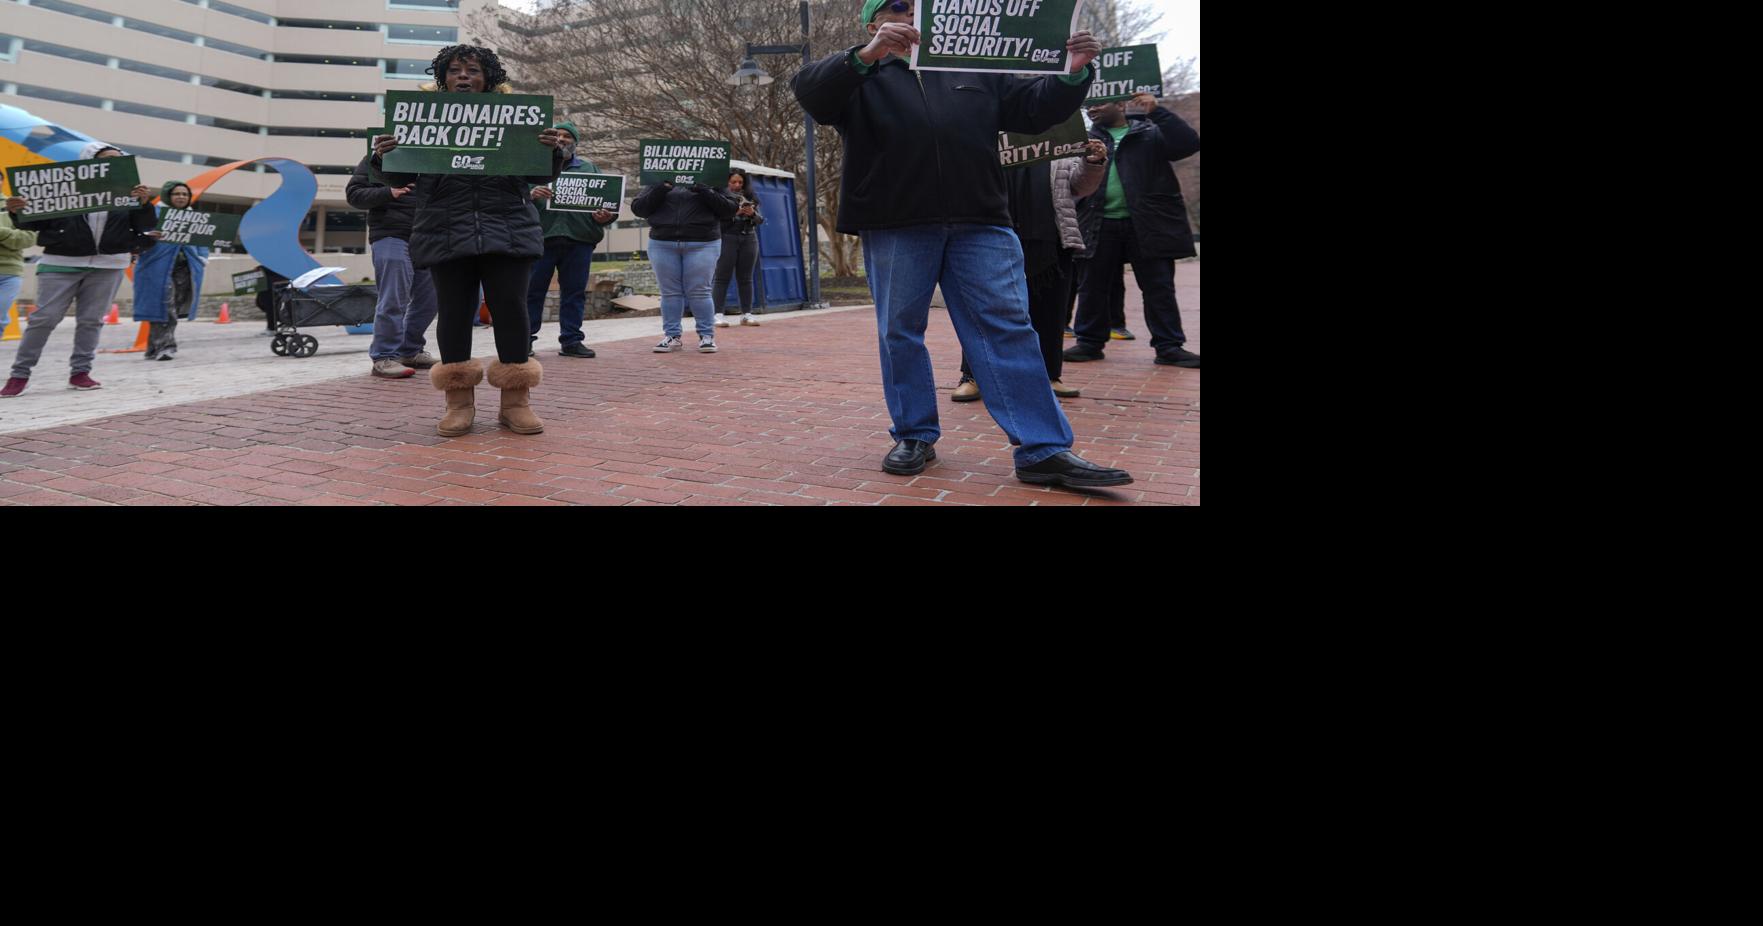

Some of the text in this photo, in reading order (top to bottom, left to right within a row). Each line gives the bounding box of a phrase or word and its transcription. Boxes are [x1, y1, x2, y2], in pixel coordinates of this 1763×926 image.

[931, 0, 1043, 17] HANDS OFF
[931, 15, 1001, 36] SOCIAL
[929, 35, 1033, 57] SECURITY!
[1103, 51, 1134, 68] OFF
[1087, 79, 1134, 98] RITY!
[393, 101, 546, 126] BILLIONAIRES:
[393, 124, 504, 147] BACK OFF!
[643, 145, 727, 159] BILLIONAIRES:
[1000, 140, 1050, 166] RITY!
[643, 158, 705, 171] BACK OFF!
[14, 162, 110, 187] HANDS OFF
[556, 177, 607, 188] HANDS OFF
[18, 181, 80, 200] SOCIAL
[556, 186, 588, 196] SOCIAL
[22, 191, 112, 215] SECURITY!
[555, 195, 603, 206] SECURITY!
[164, 208, 210, 224] HANDS
[161, 219, 216, 235] OFF OUR
[161, 230, 192, 243] DATA
